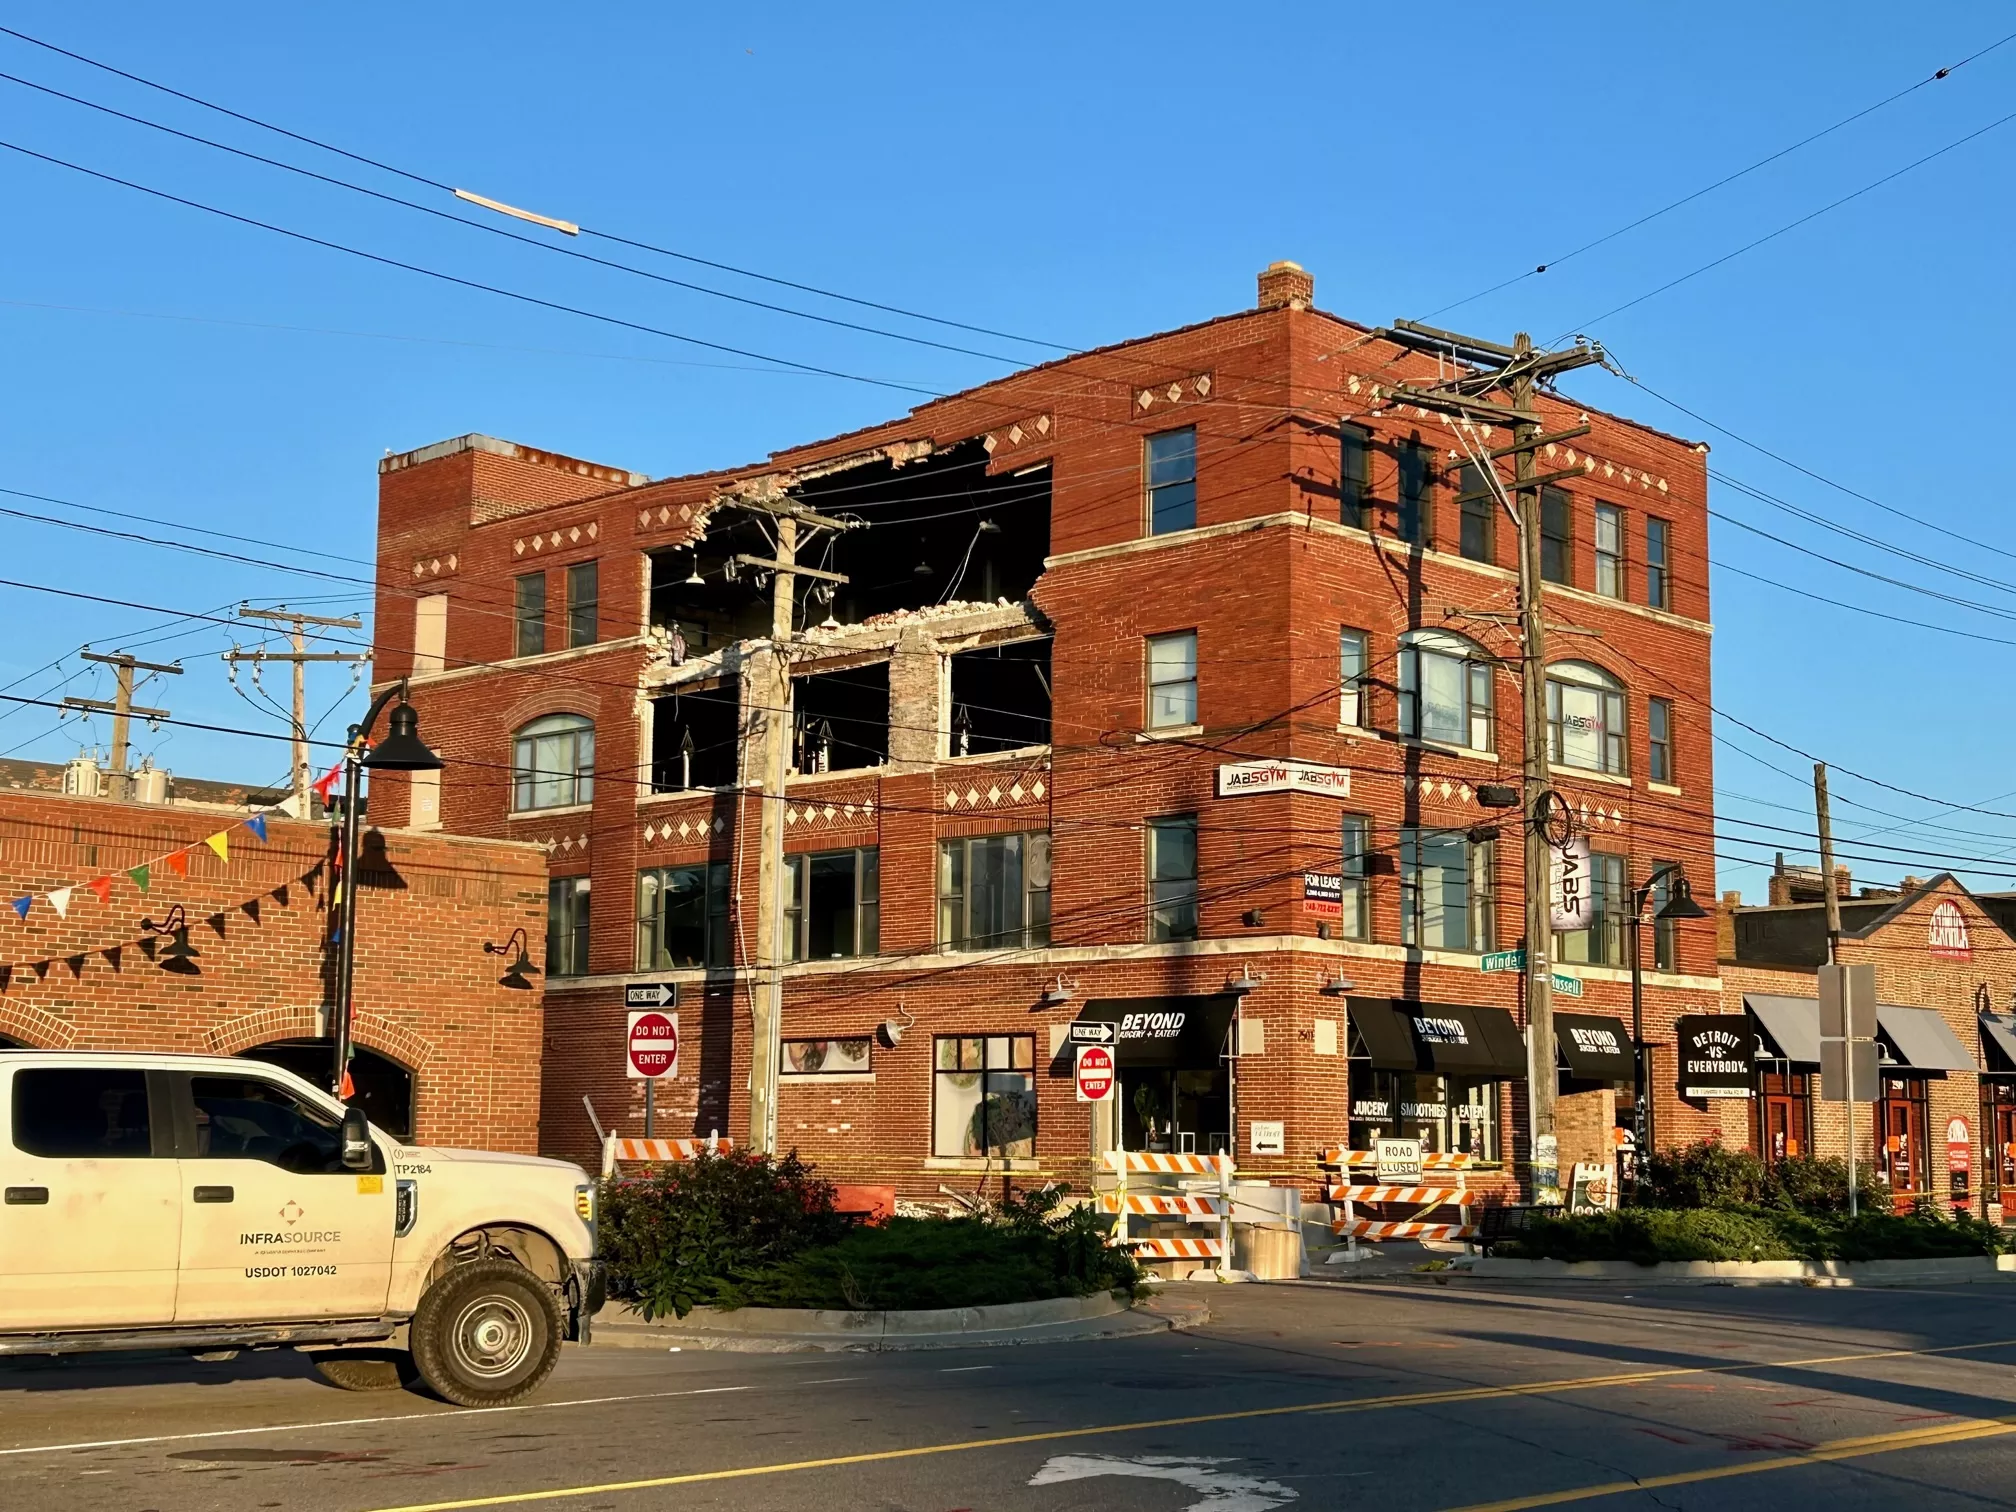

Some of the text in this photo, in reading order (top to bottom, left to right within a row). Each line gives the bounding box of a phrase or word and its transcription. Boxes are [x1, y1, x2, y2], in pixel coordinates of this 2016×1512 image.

[1305, 874, 1341, 889] FOR LEASE
[1562, 847, 1580, 917] JABS
[1486, 954, 1521, 970] Winder
[1552, 975, 1579, 994] Russell
[630, 991, 660, 1001] ONE WAY
[1121, 1013, 1185, 1030] BEYOND
[1413, 1017, 1465, 1035] BEYOND
[636, 1026, 670, 1036] DO NOT
[1074, 1028, 1086, 1036] ONE
[1154, 1029, 1180, 1038] EATERY
[1570, 1028, 1617, 1047] BEYOND
[1693, 1031, 1740, 1048] DETROIT
[639, 1054, 667, 1064] ENTER
[1083, 1058, 1108, 1066] DO NOT
[1085, 1081, 1106, 1090] ENTER
[1354, 1101, 1388, 1116] JUICERY
[1401, 1103, 1447, 1118] SMOOTHIES
[1459, 1105, 1487, 1118] EATERY
[1385, 1147, 1412, 1157] ROAD
[395, 1164, 431, 1174] TP2184
[1380, 1162, 1418, 1173] CLOSED
[240, 1231, 341, 1244] INFRASOURCE
[245, 1265, 337, 1278] USDOT 1027042
